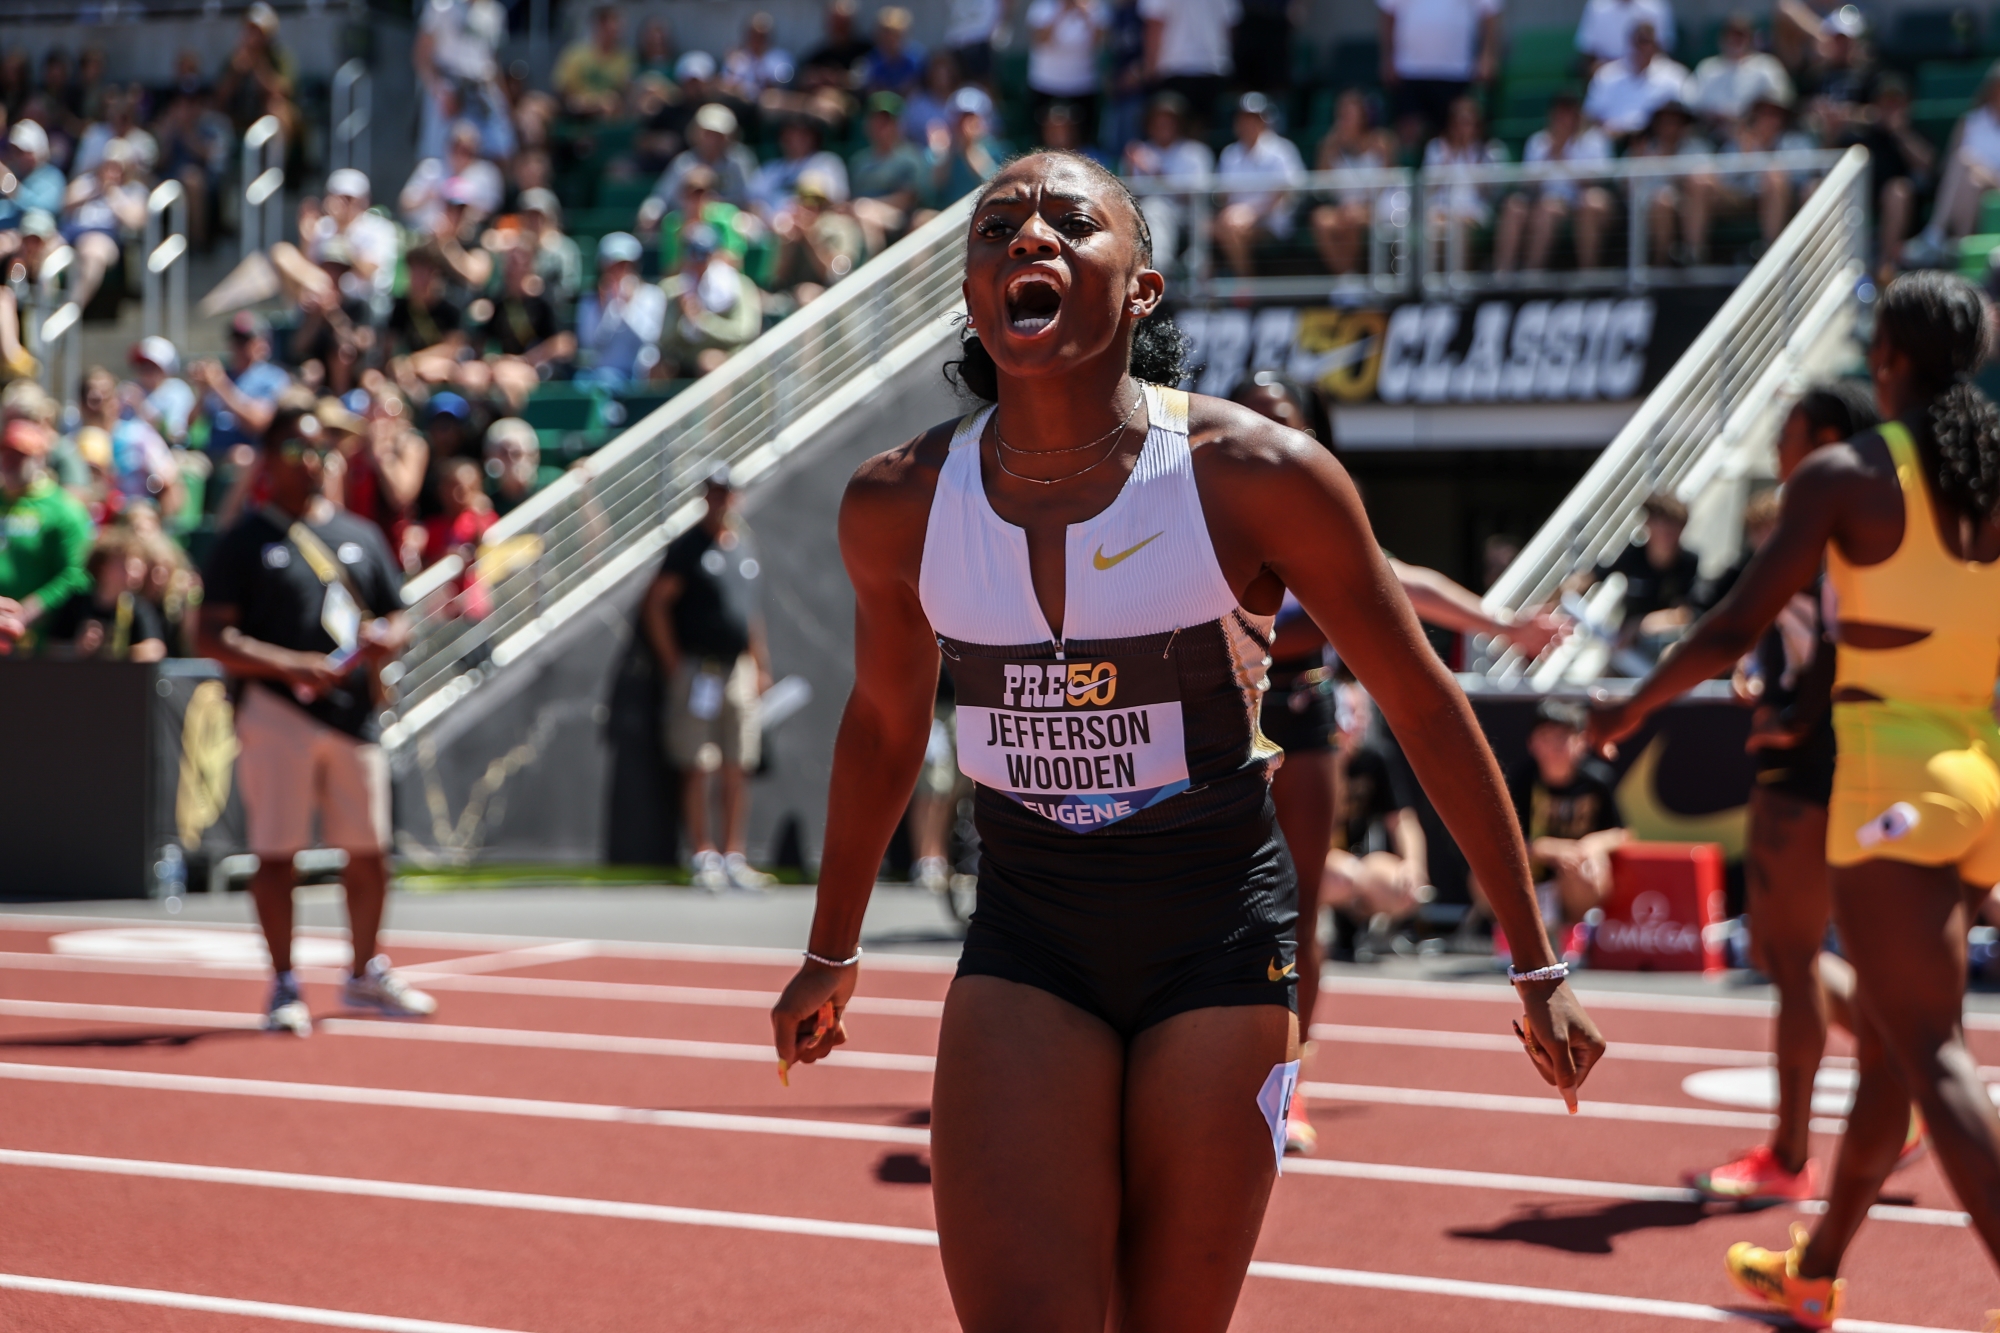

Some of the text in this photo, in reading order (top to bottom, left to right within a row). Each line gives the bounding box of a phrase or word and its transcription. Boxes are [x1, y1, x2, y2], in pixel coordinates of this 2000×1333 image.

[1377, 299, 1655, 401] CLASSIC
[987, 710, 1151, 750] JEFFERSON
[1005, 752, 1136, 790] WOODEN
[1022, 800, 1132, 825] EUGENE
